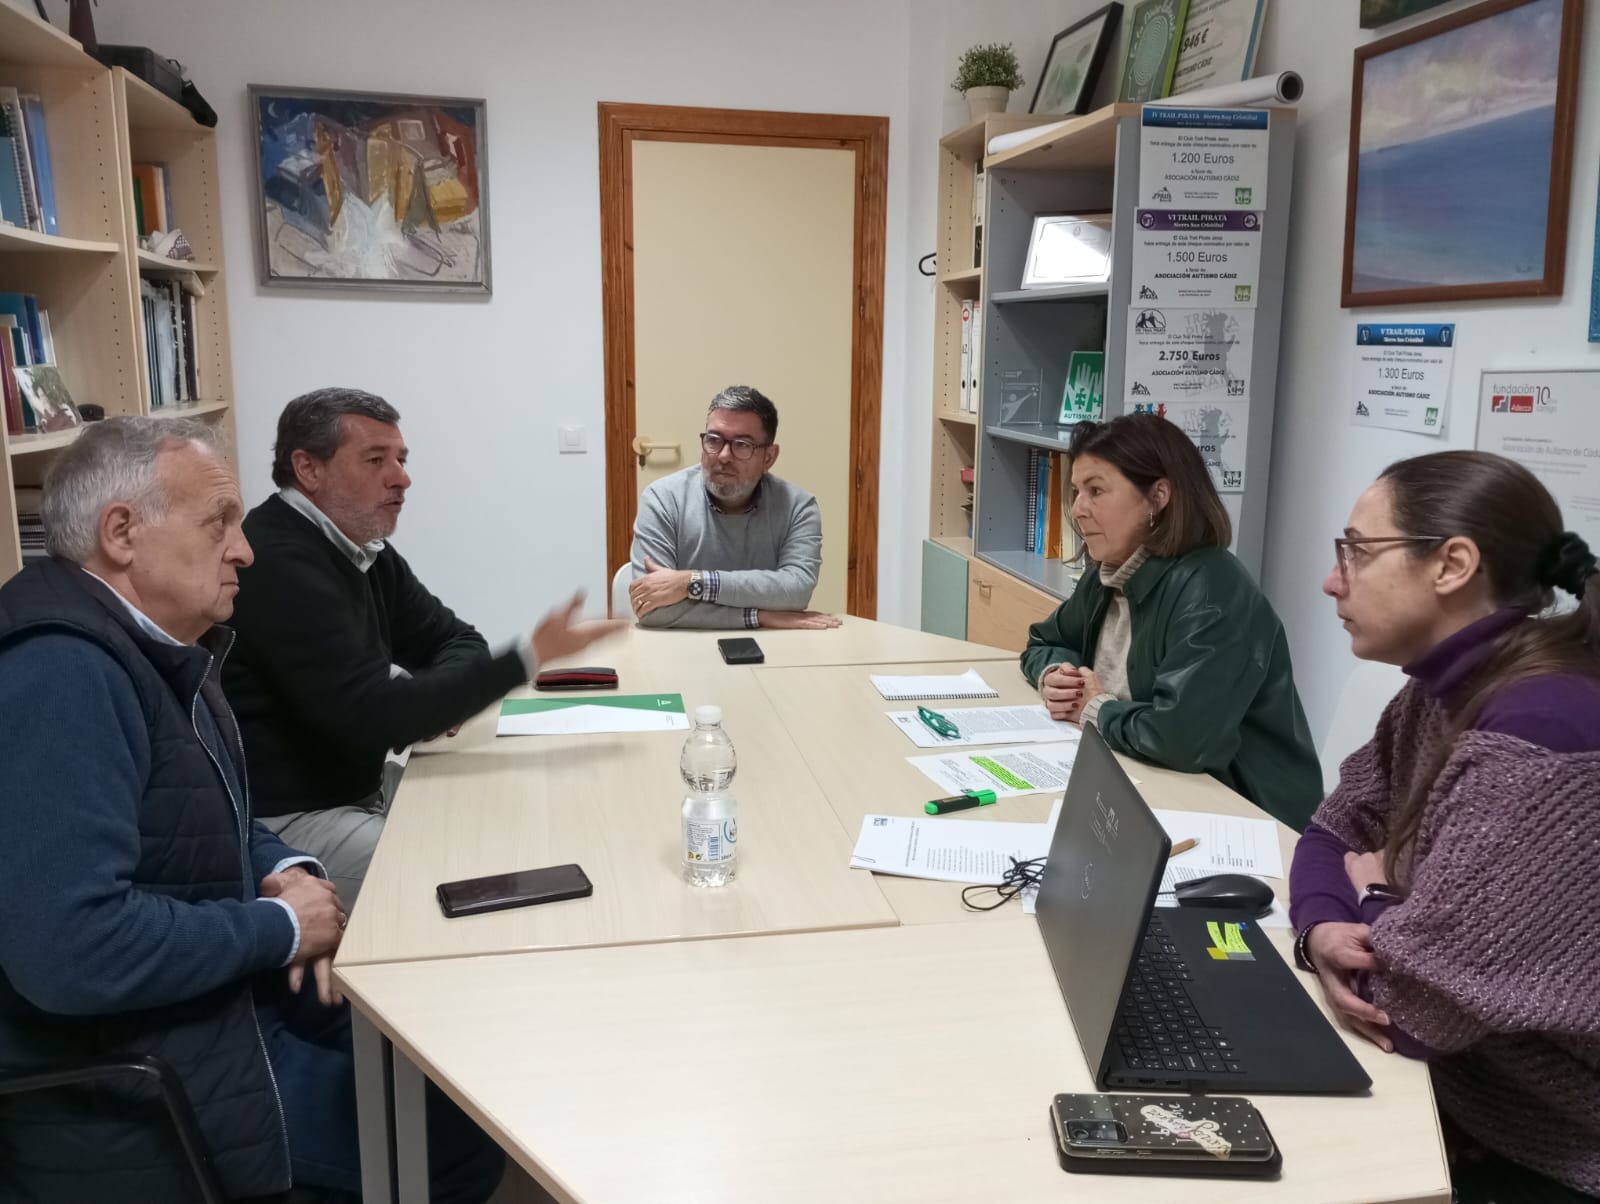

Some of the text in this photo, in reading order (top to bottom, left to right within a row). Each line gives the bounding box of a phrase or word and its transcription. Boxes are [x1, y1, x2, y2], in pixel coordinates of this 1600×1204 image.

[1172, 153, 1235, 164] 1.200 Euros
[1167, 252, 1228, 263] 1.500 Euros
[1404, 328, 1426, 336] PIRATA
[1158, 351, 1221, 361] 2.750 Euros
[1379, 368, 1425, 381] 1.300 Euros
[1493, 383, 1551, 405] fundación 10
